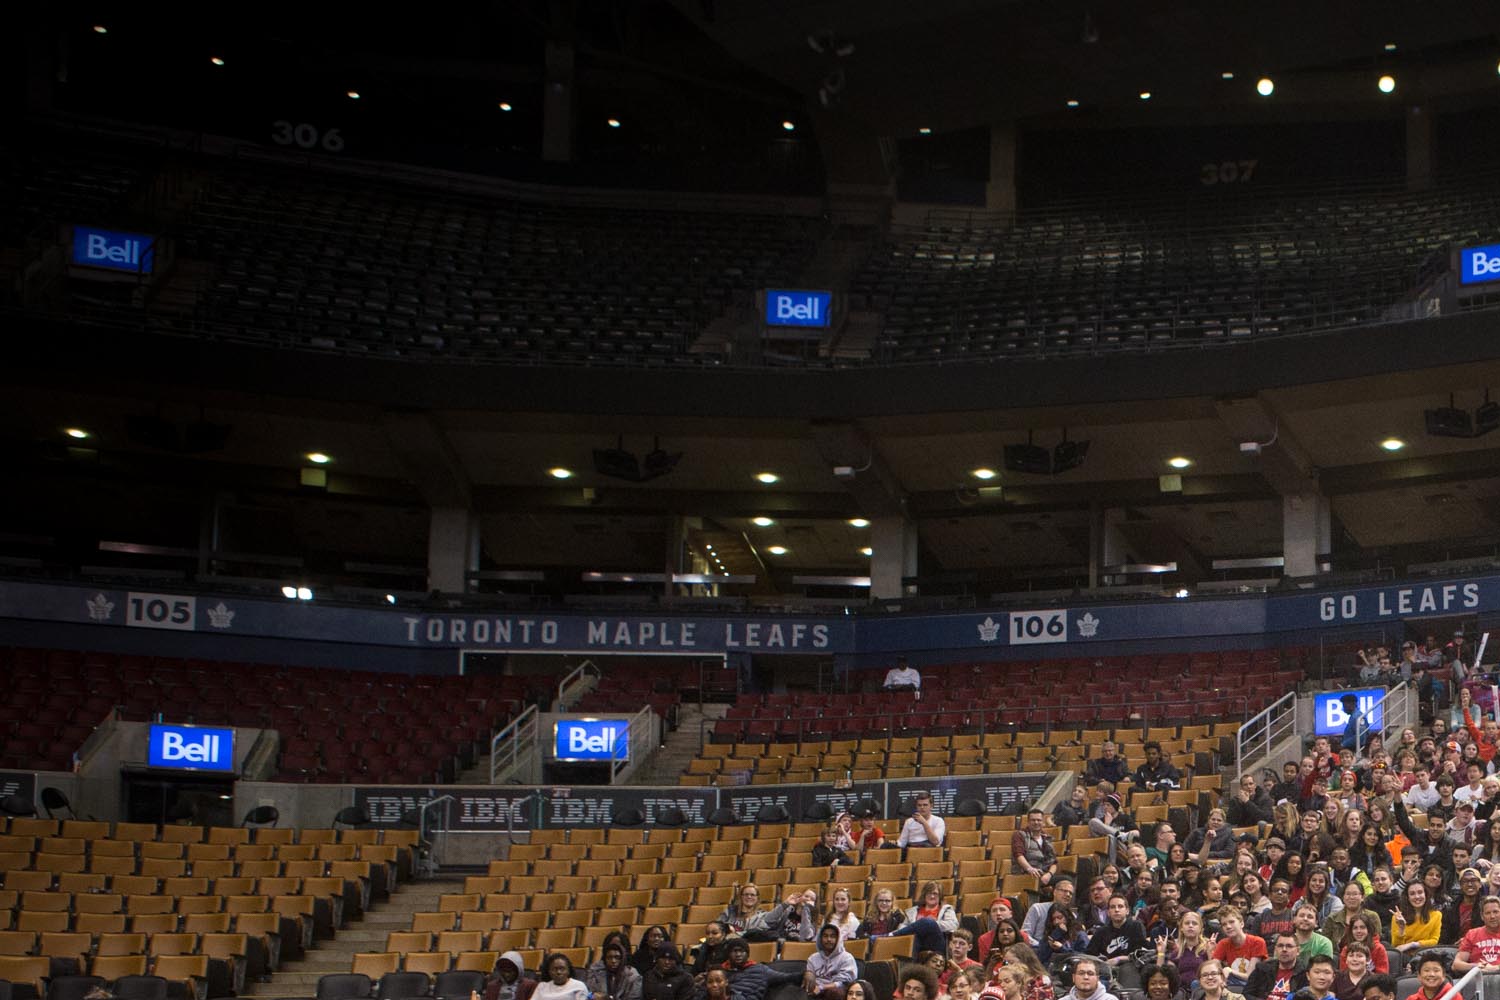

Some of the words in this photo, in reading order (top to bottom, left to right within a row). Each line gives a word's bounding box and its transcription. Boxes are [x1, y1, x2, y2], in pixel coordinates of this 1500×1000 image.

[271, 119, 345, 153] 306
[1199, 160, 1258, 185] 307
[88, 233, 139, 265] Bell
[776, 295, 819, 320] Bell
[131, 599, 191, 624] 105
[1320, 593, 1357, 621] GO
[1378, 582, 1480, 616] LEAFS
[403, 616, 559, 645] TORONTO
[587, 620, 696, 647] MAPLE
[725, 622, 829, 648] LEAFS
[1014, 615, 1064, 638] 106
[1326, 696, 1373, 728] Bll
[162, 731, 219, 763] Bell
[569, 727, 615, 753] Bell
[460, 797, 525, 823] IBM
[550, 798, 614, 824] IBM
[1260, 921, 1294, 935] RAPTORS
